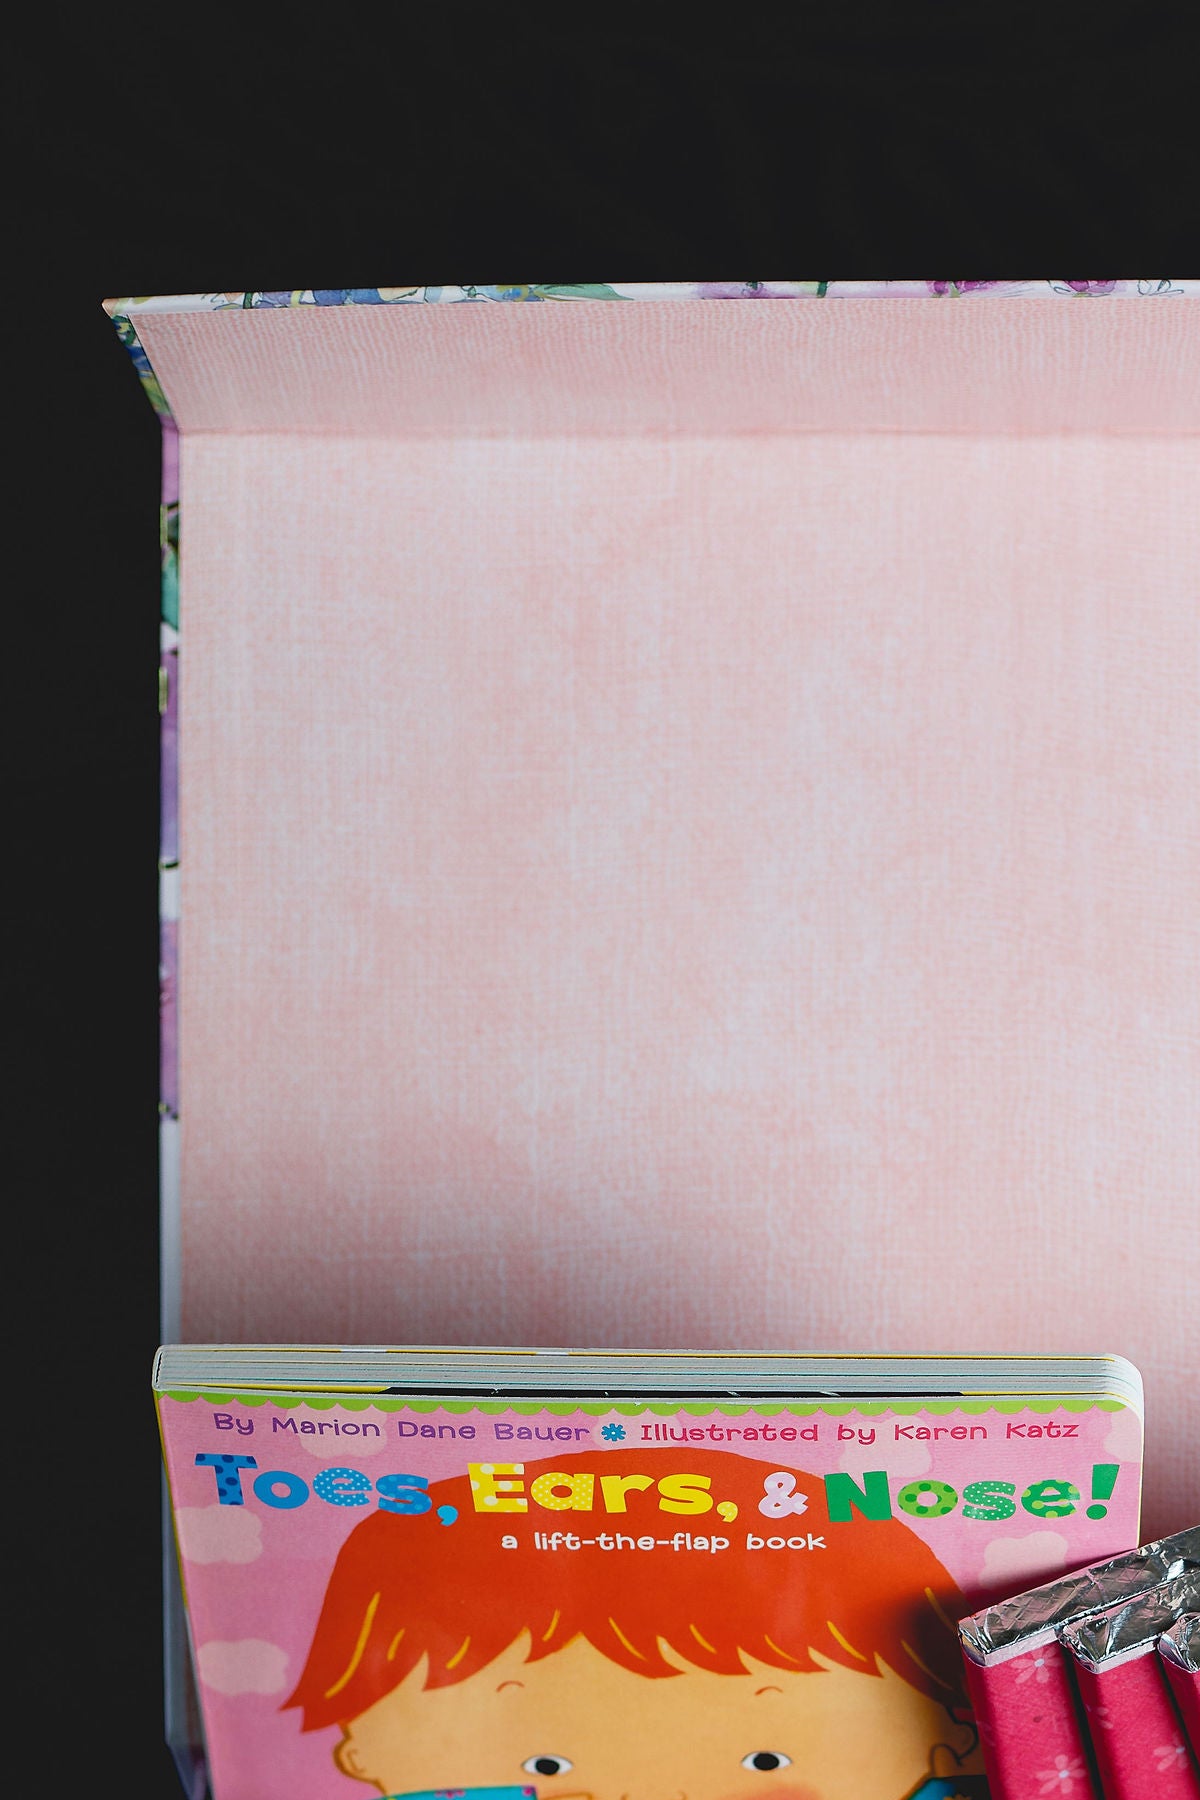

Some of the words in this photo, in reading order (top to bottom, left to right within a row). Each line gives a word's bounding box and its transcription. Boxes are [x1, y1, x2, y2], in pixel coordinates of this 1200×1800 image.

[213, 1412, 254, 1436] By
[272, 1416, 380, 1437] Marion
[398, 1420, 476, 1440] Dane
[494, 1422, 590, 1441] Bauer
[640, 1423, 818, 1442] Illustrated
[837, 1423, 876, 1445] by
[894, 1422, 988, 1441] Karen
[1006, 1420, 1080, 1439] Katz
[194, 1453, 459, 1526] Toes,
[467, 1462, 738, 1523] Ears,
[757, 1471, 809, 1519] &
[824, 1463, 1120, 1522] Nose!
[501, 1534, 518, 1550] a
[534, 1533, 730, 1554] lift-the-flap
[746, 1533, 827, 1551] book
